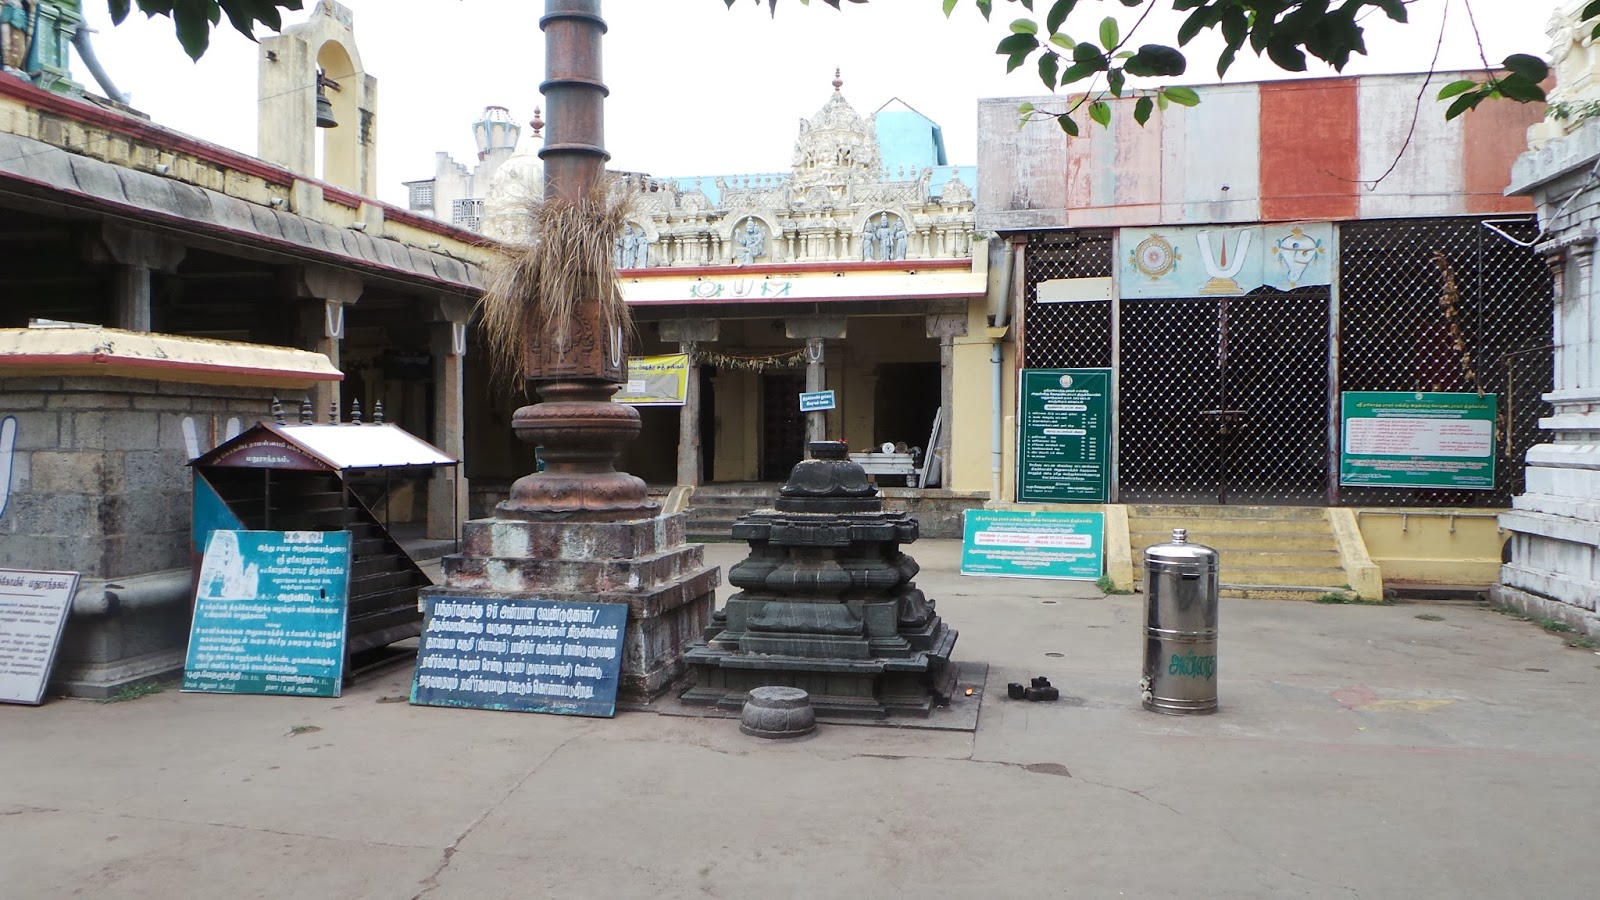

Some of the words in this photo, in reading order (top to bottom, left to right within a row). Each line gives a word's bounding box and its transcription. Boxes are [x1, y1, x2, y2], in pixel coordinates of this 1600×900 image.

[277, 593, 315, 603] அறிவிப்பு
[434, 600, 484, 619] பக்தர்களுக்கு
[499, 603, 536, 620] அன்பான
[426, 618, 484, 634] திருக்கோயிலுக்கு
[486, 623, 512, 636] வருகை
[533, 622, 567, 639] பக்தர்கள்
